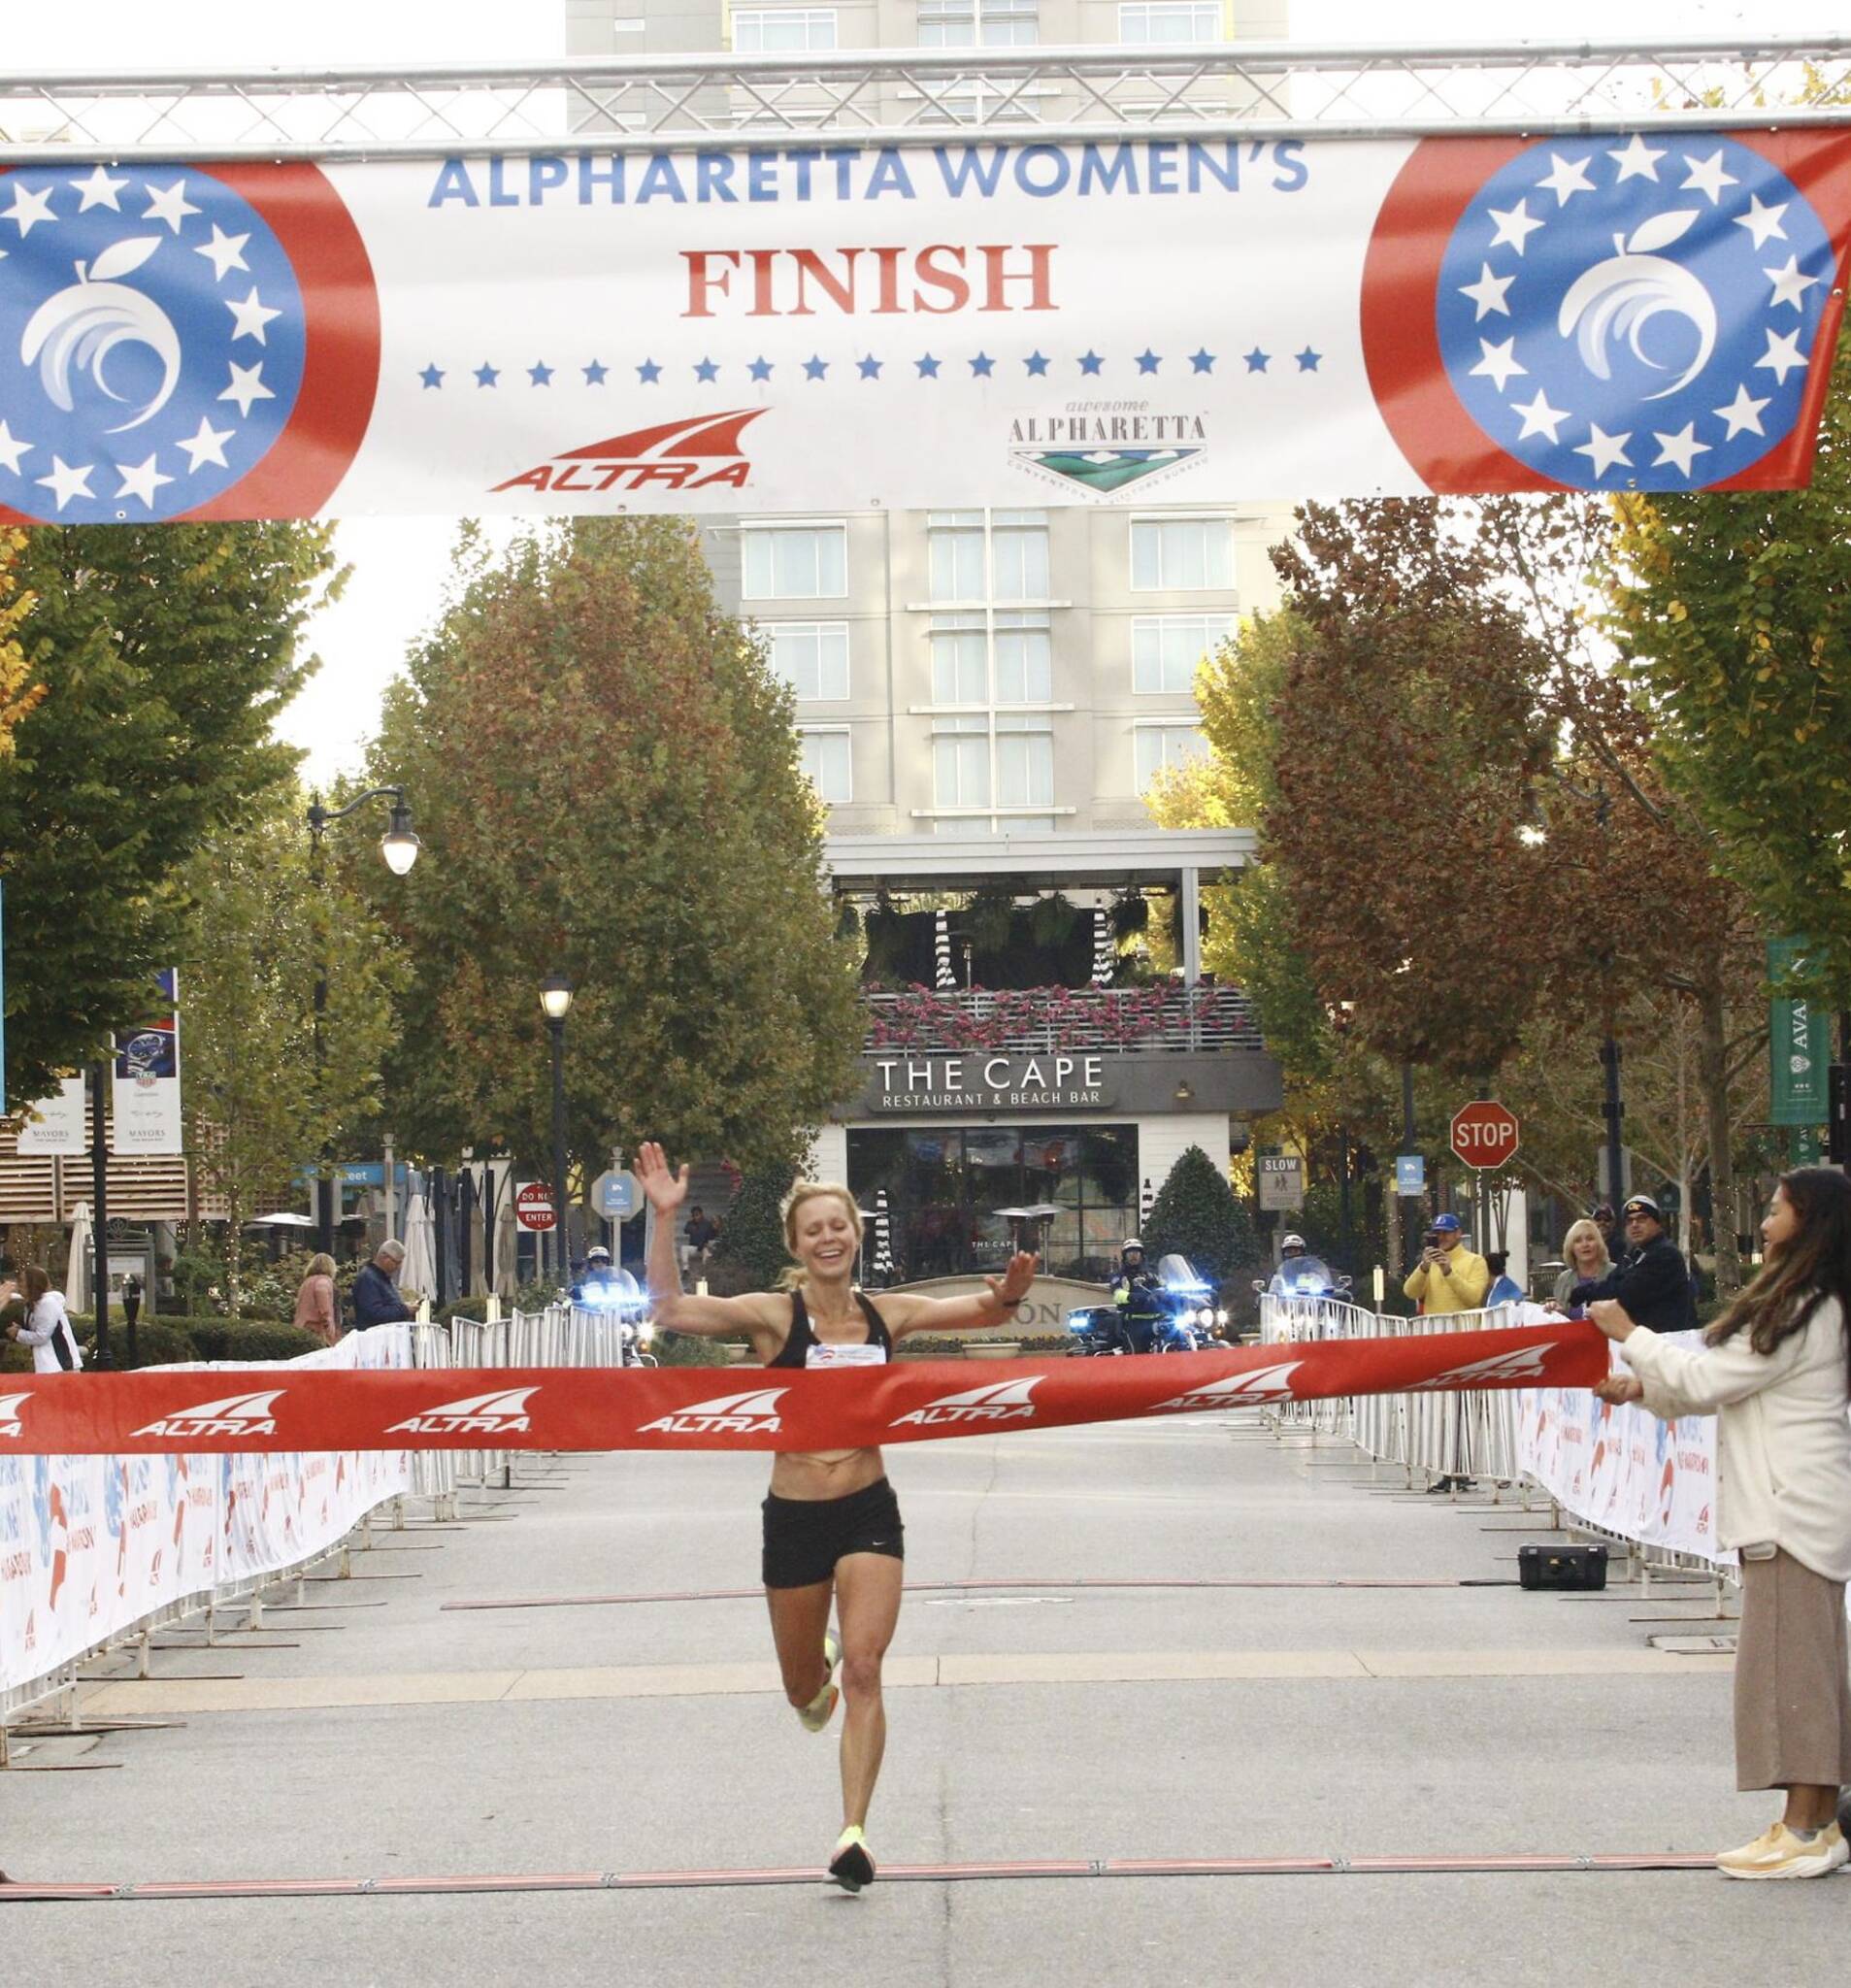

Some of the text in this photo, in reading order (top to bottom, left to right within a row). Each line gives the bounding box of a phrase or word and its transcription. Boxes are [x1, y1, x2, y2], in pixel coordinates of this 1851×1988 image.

[427, 138, 1308, 208] ALPHARETTA WOMEN'S
[678, 245, 1060, 317] FINISH
[1009, 416, 1206, 442] ALPHARETTA
[486, 462, 750, 492] ALTRA
[876, 1057, 1103, 1091] THE CAPE
[883, 1091, 1101, 1108] RESTAURANT & BEACH BAR
[1456, 1122, 1513, 1147] STOP
[1265, 1158, 1297, 1171] SLOW
[522, 1193, 534, 1202] DO
[525, 1213, 552, 1222] ENTER
[1399, 1364, 1545, 1391] ALTRA
[1148, 1391, 1294, 1409] ALTRA
[382, 1416, 532, 1433] ALTRA
[636, 1415, 782, 1433] ALTRA
[887, 1405, 1036, 1428] ALTRA
[129, 1419, 278, 1437] ALTRA
